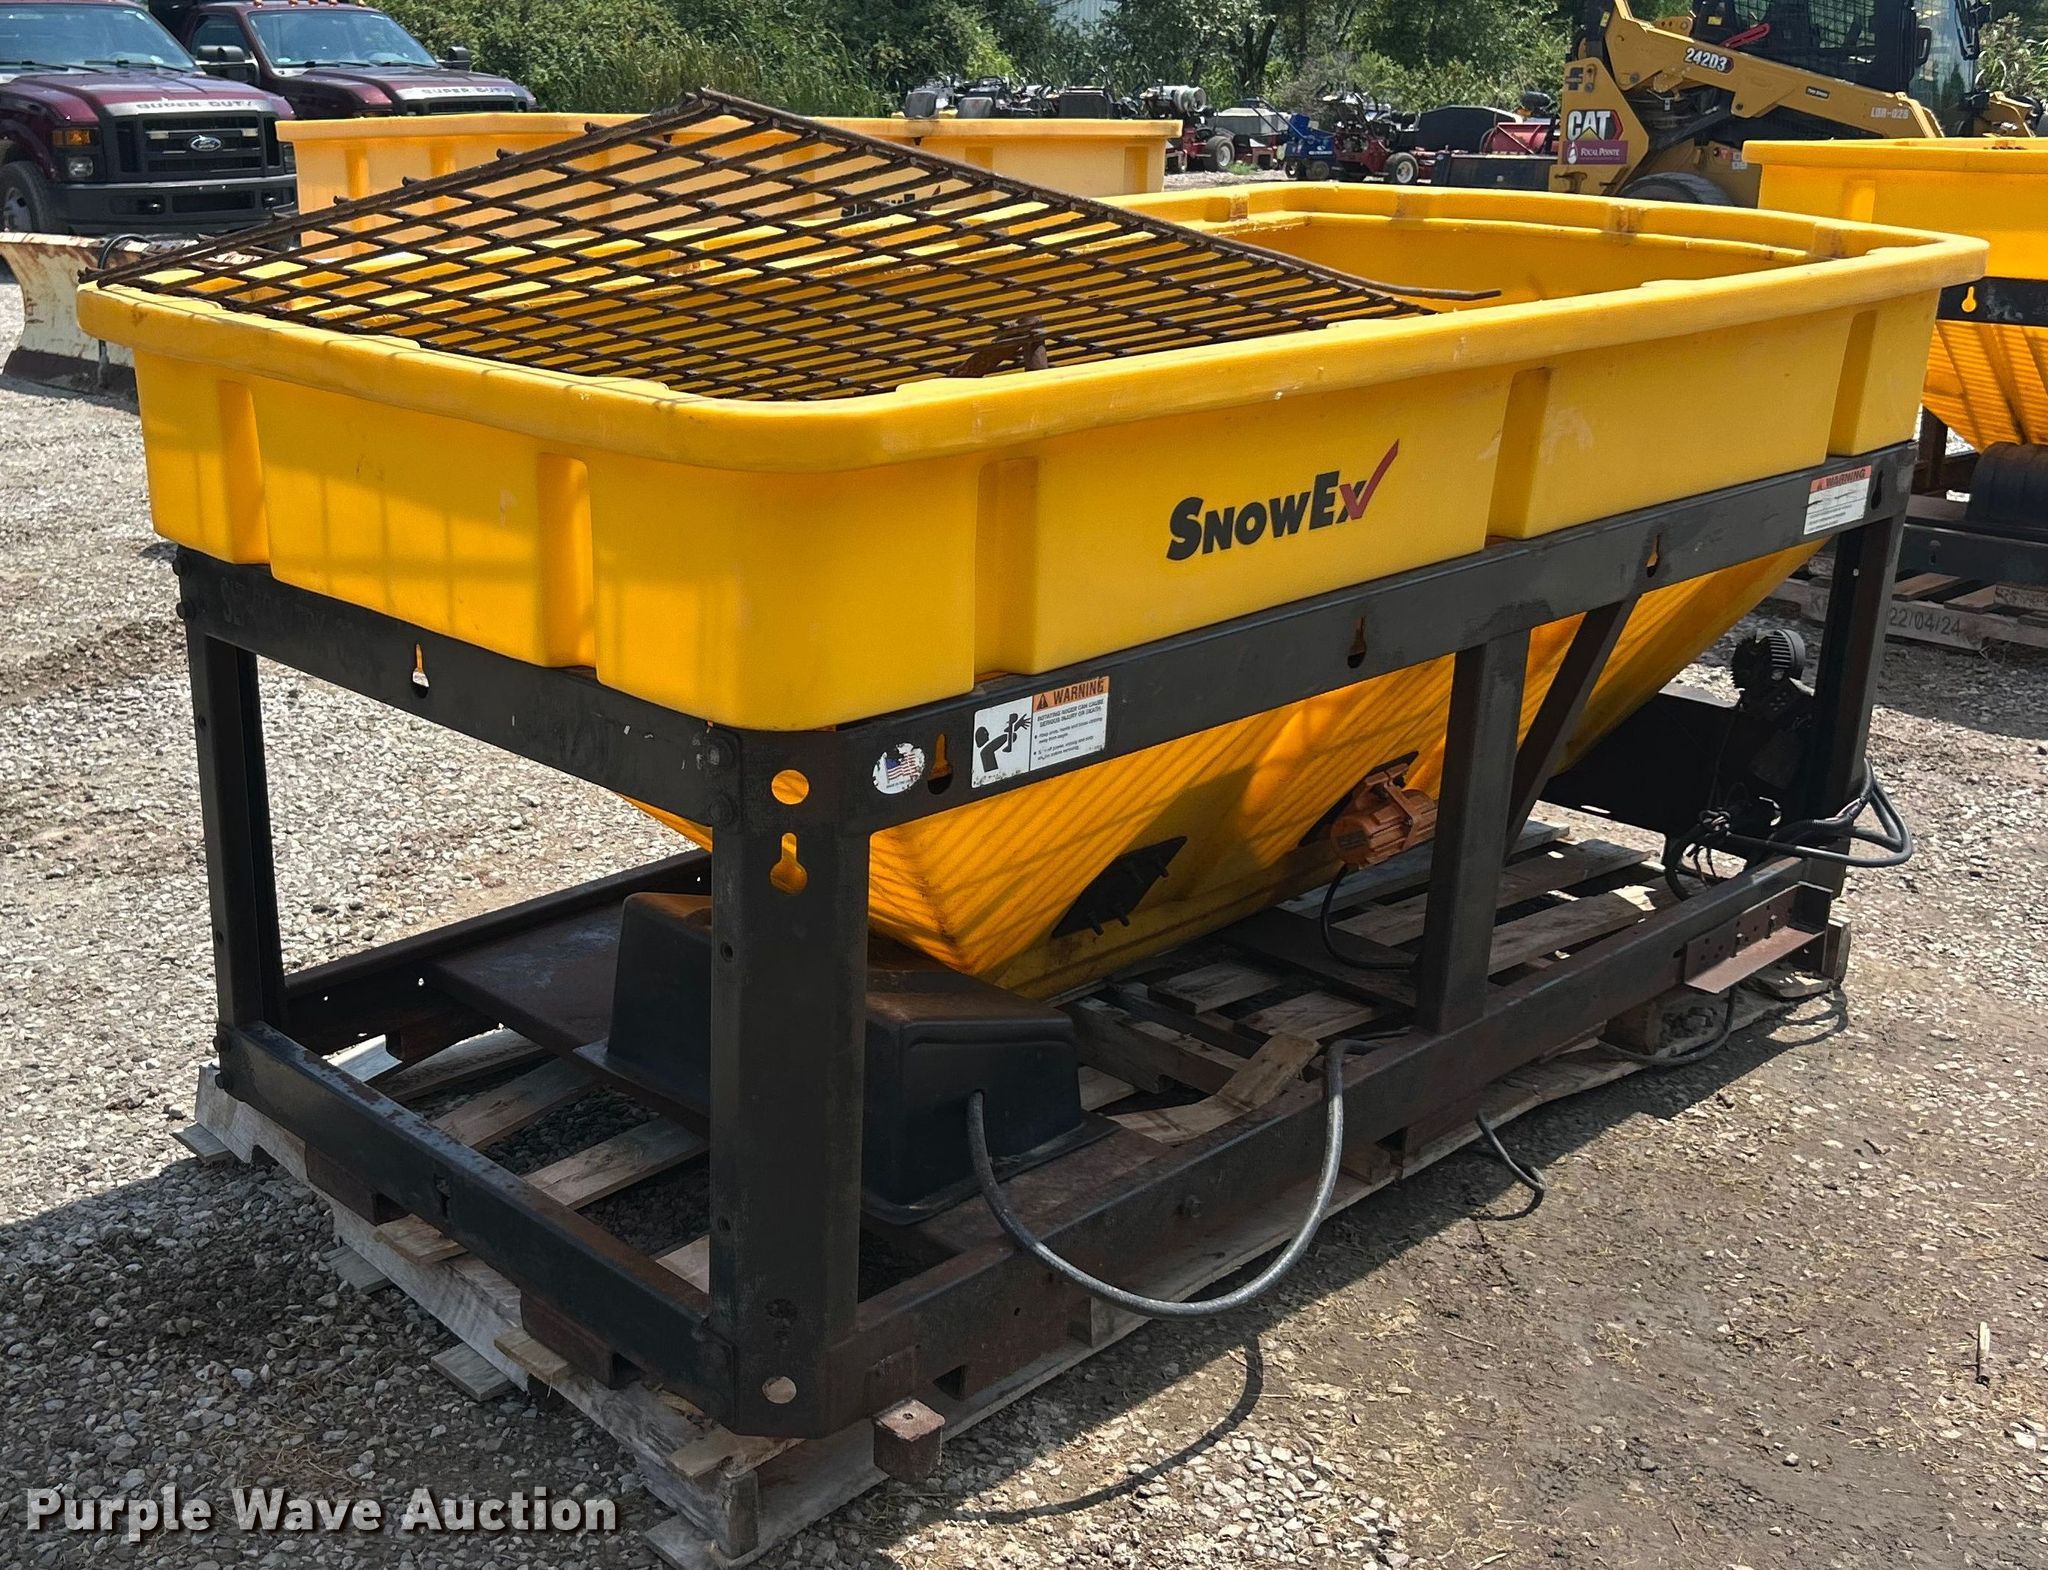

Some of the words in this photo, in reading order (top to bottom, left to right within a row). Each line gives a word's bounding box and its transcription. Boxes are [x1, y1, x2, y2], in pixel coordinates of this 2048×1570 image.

[1684, 47, 1728, 72] 242D3
[1567, 110, 1611, 141] CAT
[1888, 606, 1961, 637] 22/04/24
[1053, 679, 1105, 705] WARNING
